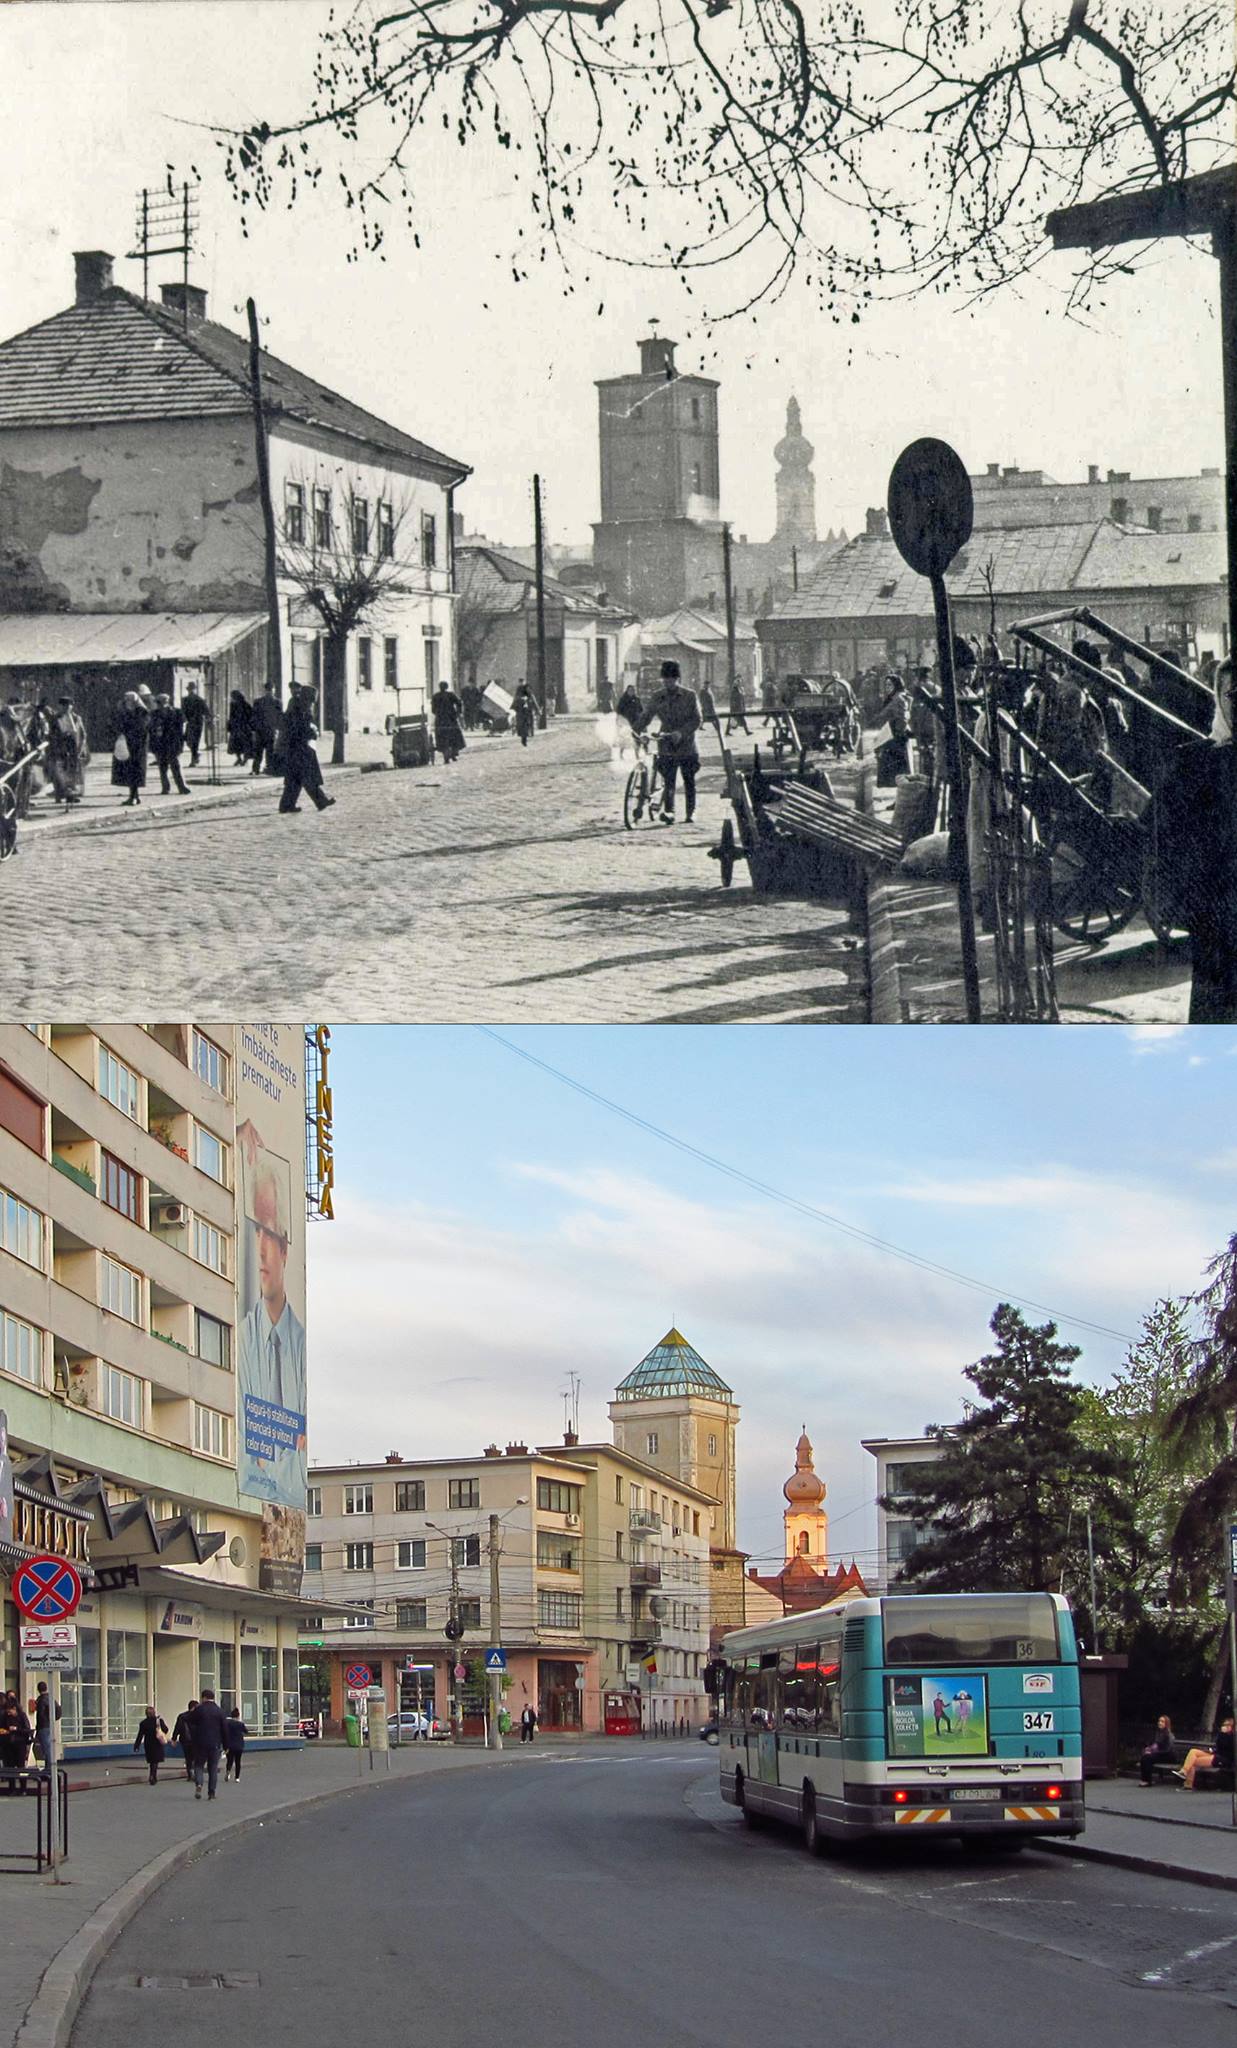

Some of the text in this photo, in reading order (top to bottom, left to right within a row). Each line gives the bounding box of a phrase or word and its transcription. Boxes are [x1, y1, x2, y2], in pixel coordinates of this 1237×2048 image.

[242, 1061, 281, 1103] prematur
[317, 1025, 335, 1220] CINEMA
[1025, 1713, 1052, 1730] 347
